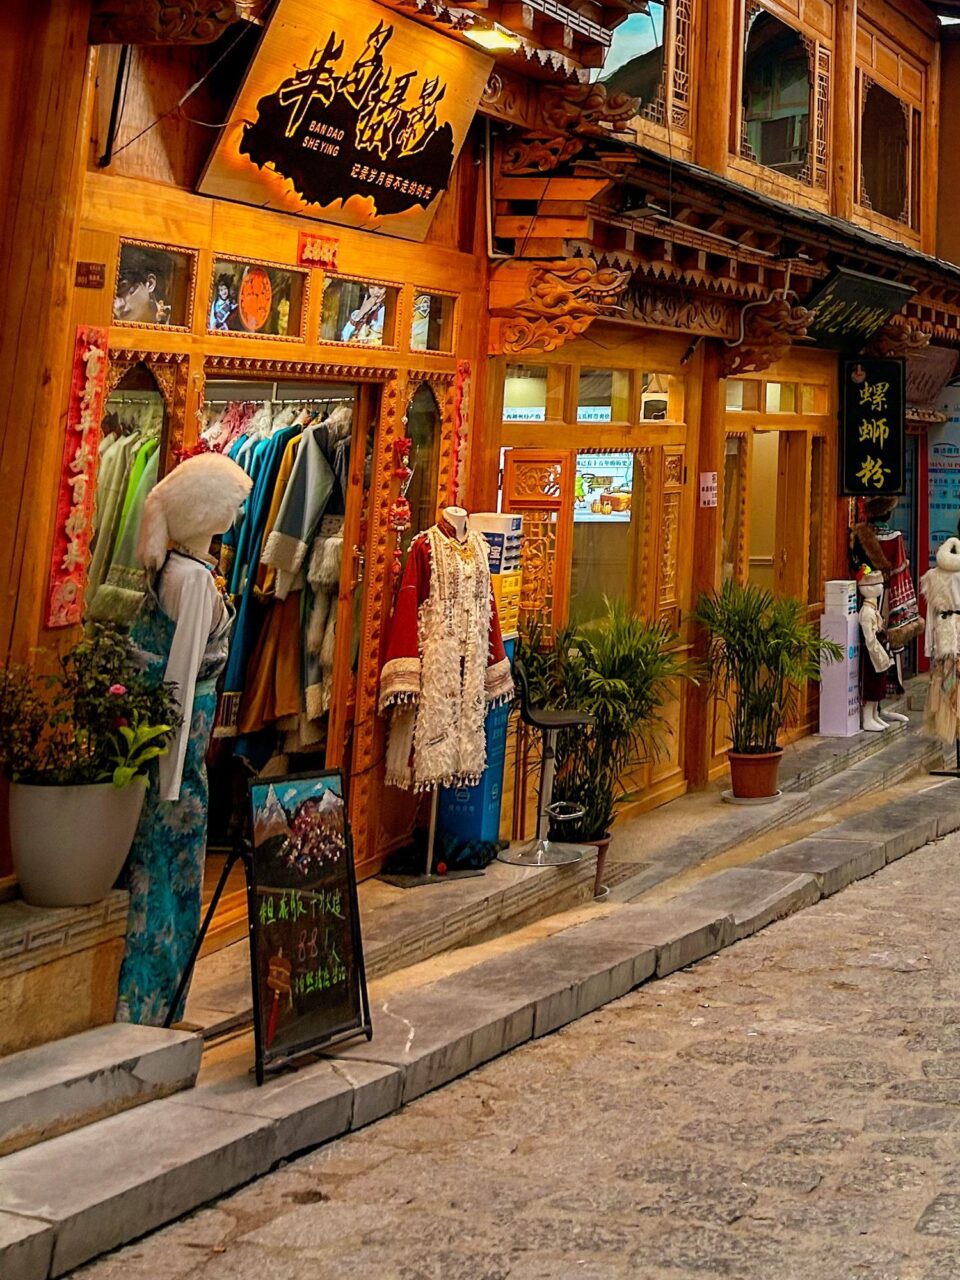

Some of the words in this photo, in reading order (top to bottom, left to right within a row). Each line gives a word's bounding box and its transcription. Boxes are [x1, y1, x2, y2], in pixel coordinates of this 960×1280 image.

[308, 120, 326, 136] BAN
[327, 125, 345, 141] DAO
[302, 136, 320, 152] SHE
[321, 141, 340, 157] YING
[350, 163, 432, 199] 记录岁月带不走的时光
[856, 381, 891, 489] 螺蛳粉
